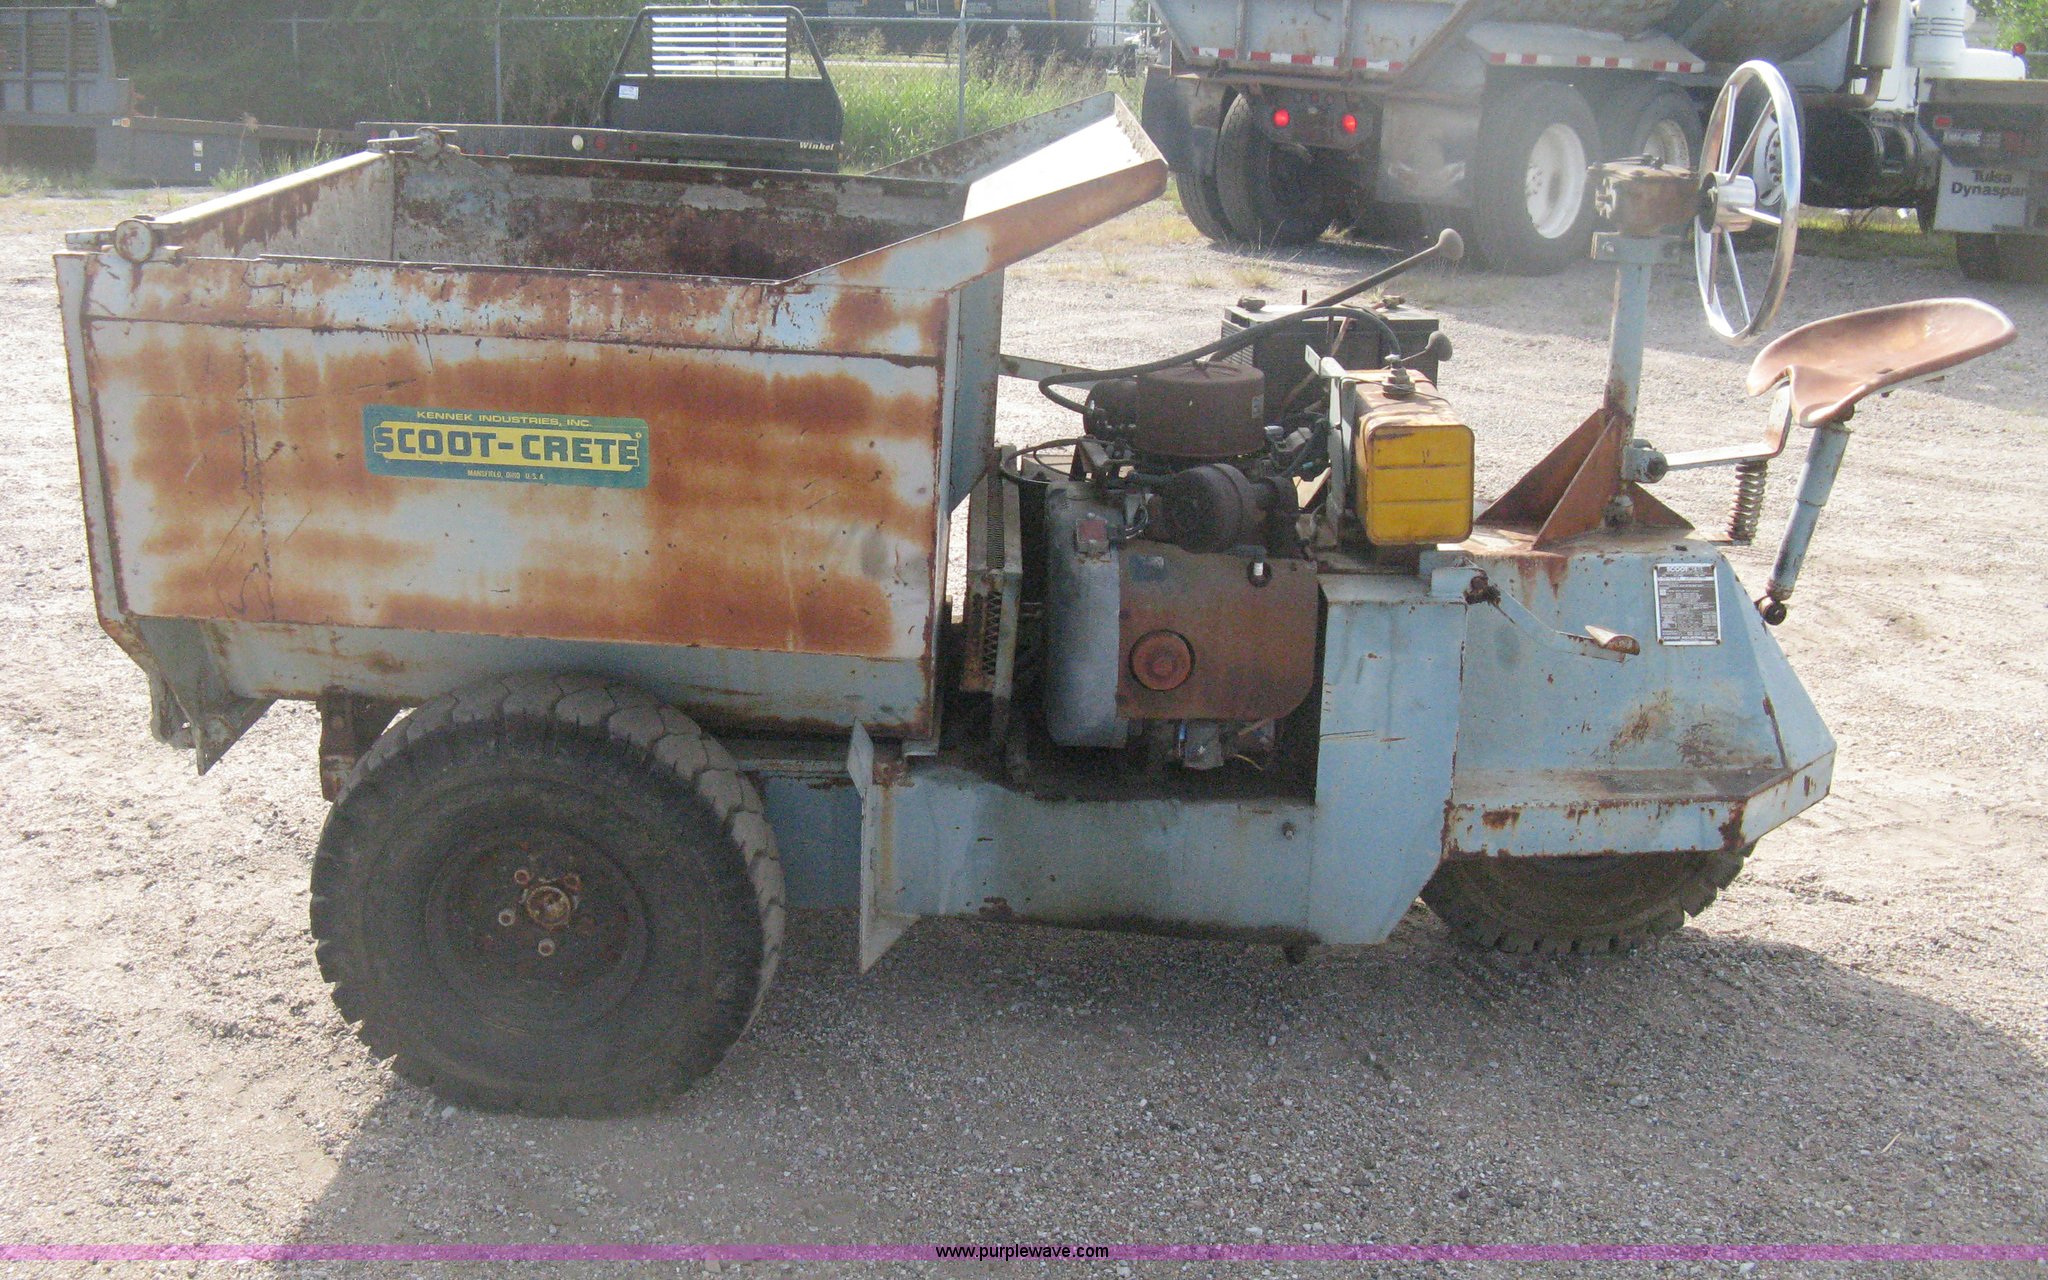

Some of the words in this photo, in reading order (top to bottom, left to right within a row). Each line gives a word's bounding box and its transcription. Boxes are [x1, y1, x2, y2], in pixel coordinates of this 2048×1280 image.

[799, 141, 835, 151] Winkel
[1972, 170, 2012, 184] Tulsa
[416, 410, 473, 422] KENNEK
[478, 414, 564, 428] INDUSTRIES,
[566, 419, 593, 428] INC.
[373, 426, 640, 466] SCOOT-CRETE
